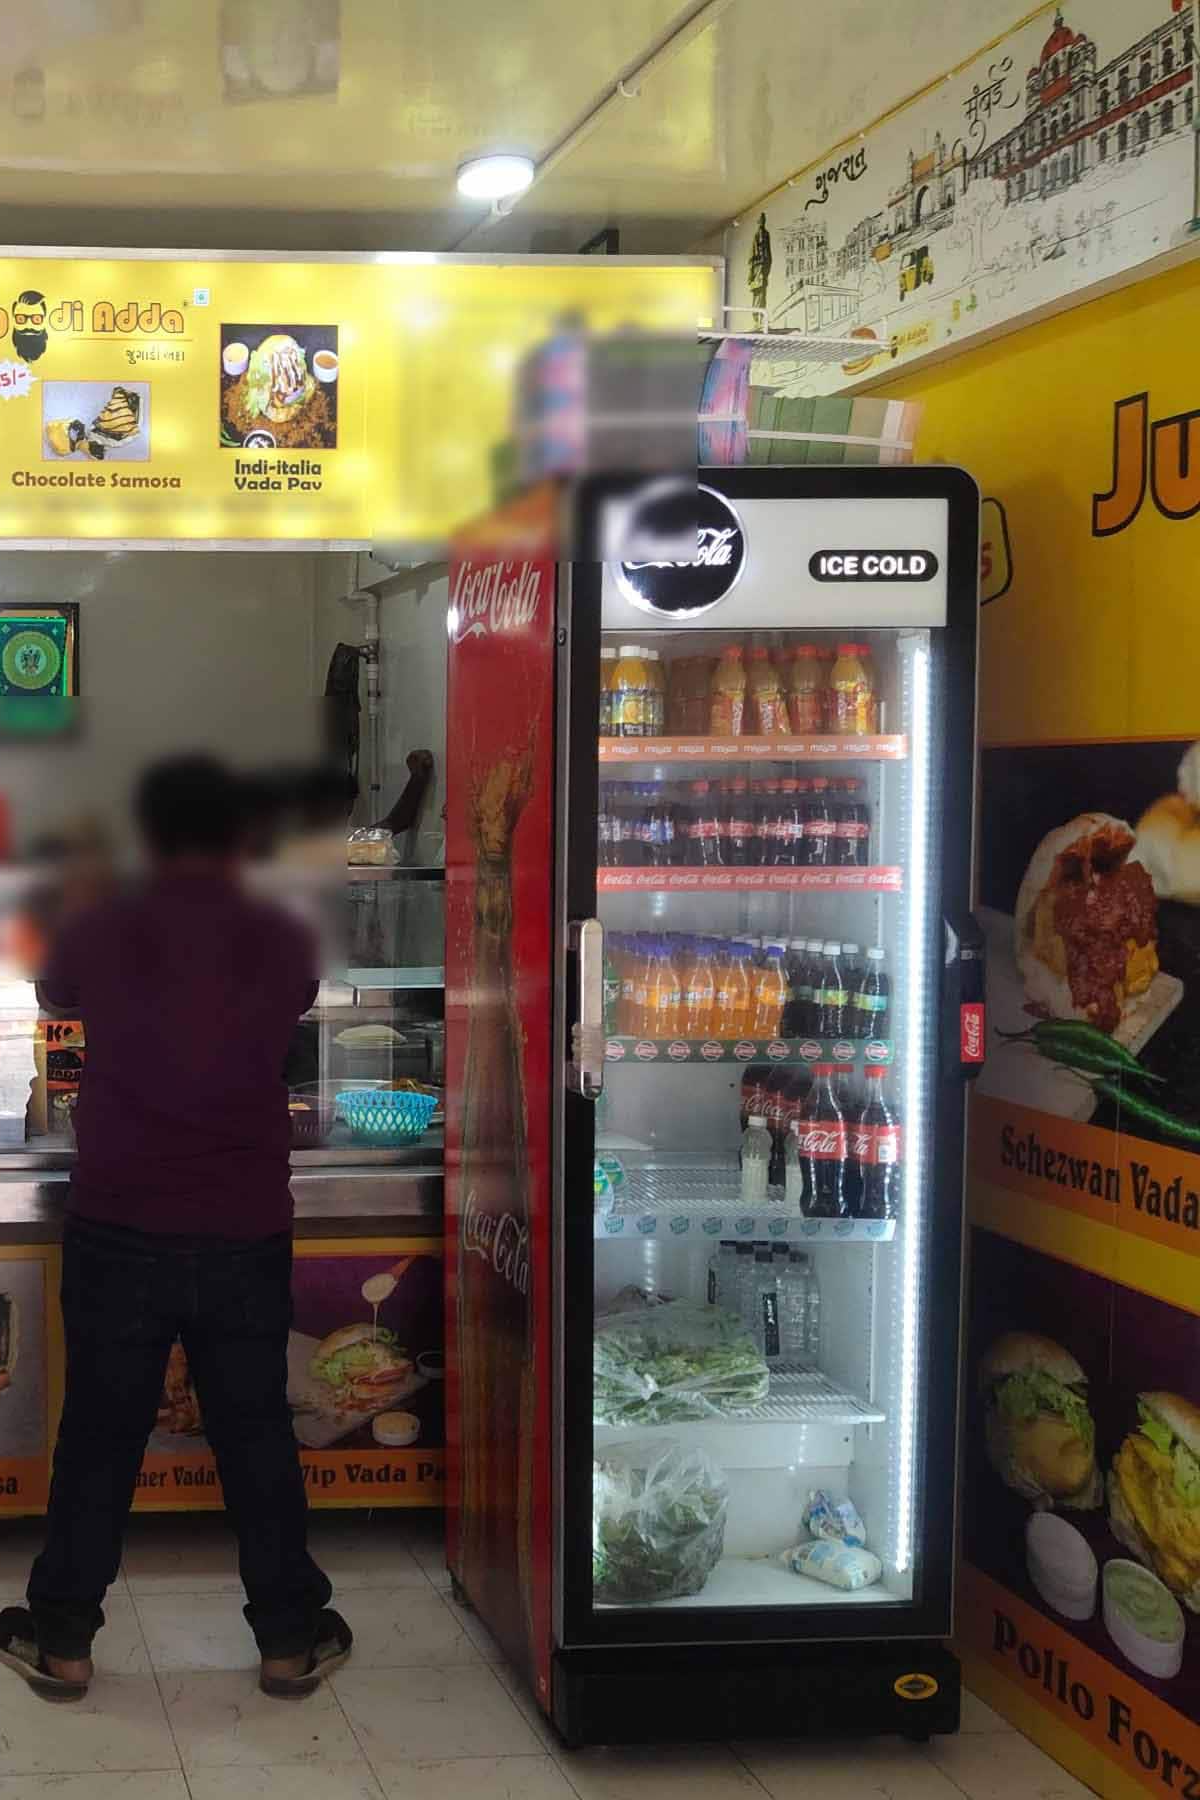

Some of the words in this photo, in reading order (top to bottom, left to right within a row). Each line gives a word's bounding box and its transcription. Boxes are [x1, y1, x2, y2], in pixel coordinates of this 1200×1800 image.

[92, 301, 184, 333] Adda
[234, 459, 322, 475] Indi-italia
[12, 471, 106, 489] Chocolate
[110, 472, 182, 489] Samosa
[234, 477, 282, 490] Vada
[288, 477, 322, 490] Pav
[820, 555, 859, 575] ICE
[862, 555, 926, 575] COLD
[1001, 1123, 1121, 1204] Schezwan
[1130, 1161, 1200, 1230] Vada
[173, 1465, 216, 1487] Vada
[345, 1463, 408, 1483] Vada
[416, 1462, 448, 1482] Pa
[993, 1609, 1094, 1721] Pollo
